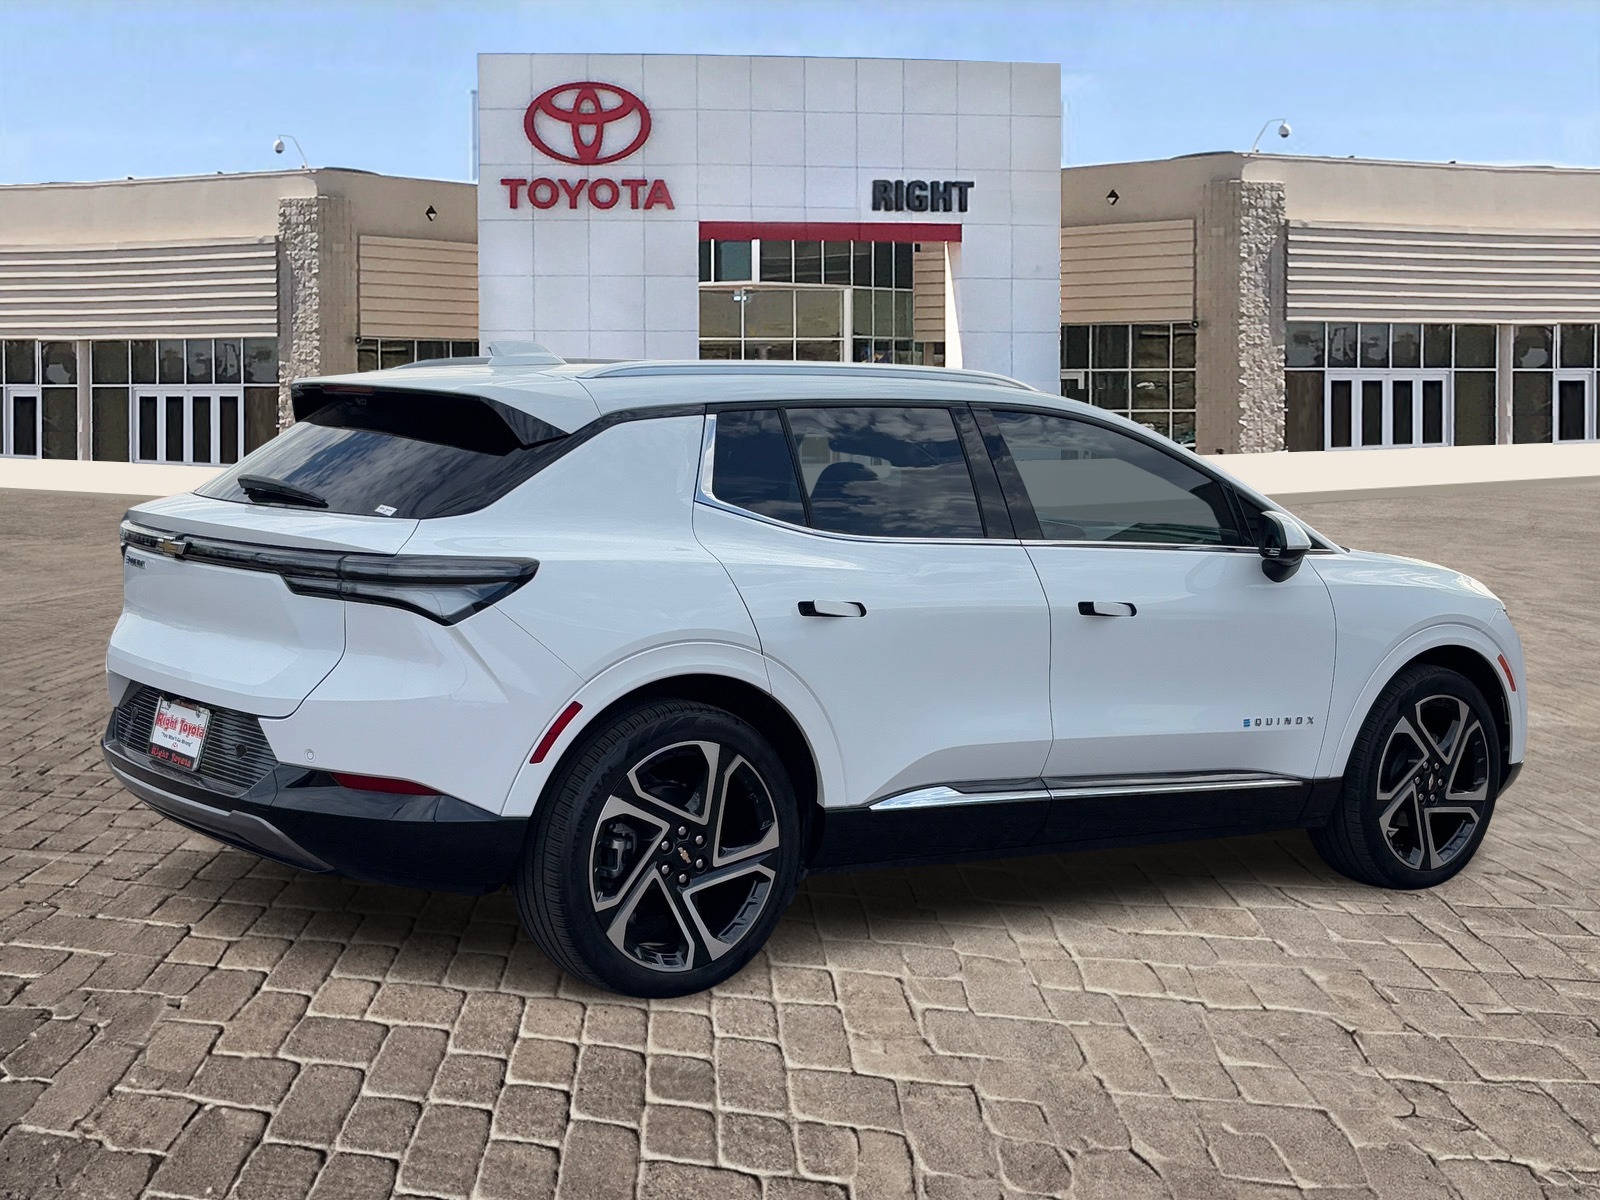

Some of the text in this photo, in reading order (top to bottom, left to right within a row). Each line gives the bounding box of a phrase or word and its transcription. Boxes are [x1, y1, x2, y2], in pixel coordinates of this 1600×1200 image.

[500, 177, 675, 210] TOYOTA
[872, 179, 975, 212] RIGHT
[156, 711, 205, 739] Right Toyota
[1243, 716, 1315, 728] EQUINOX
